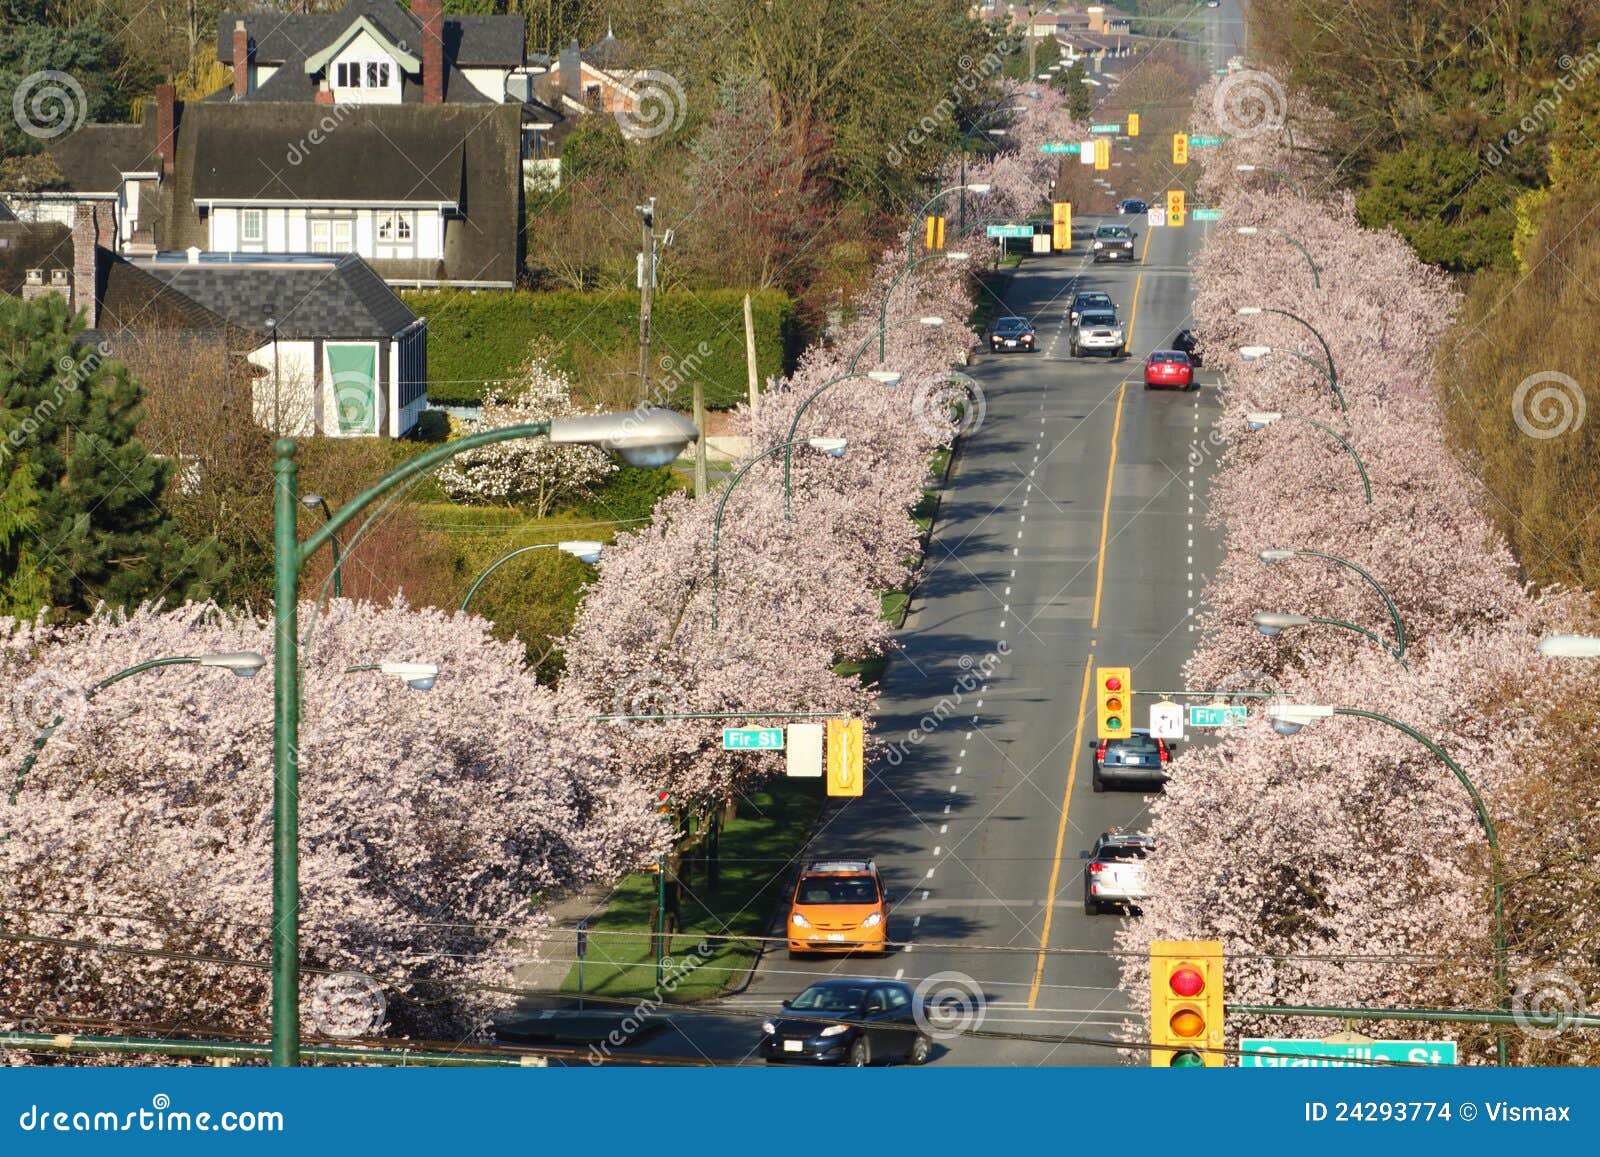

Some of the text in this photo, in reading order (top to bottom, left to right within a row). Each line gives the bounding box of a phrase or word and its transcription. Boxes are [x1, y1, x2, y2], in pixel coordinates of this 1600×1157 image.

[1196, 709, 1217, 723] Fir
[729, 731, 777, 746] Fir St
